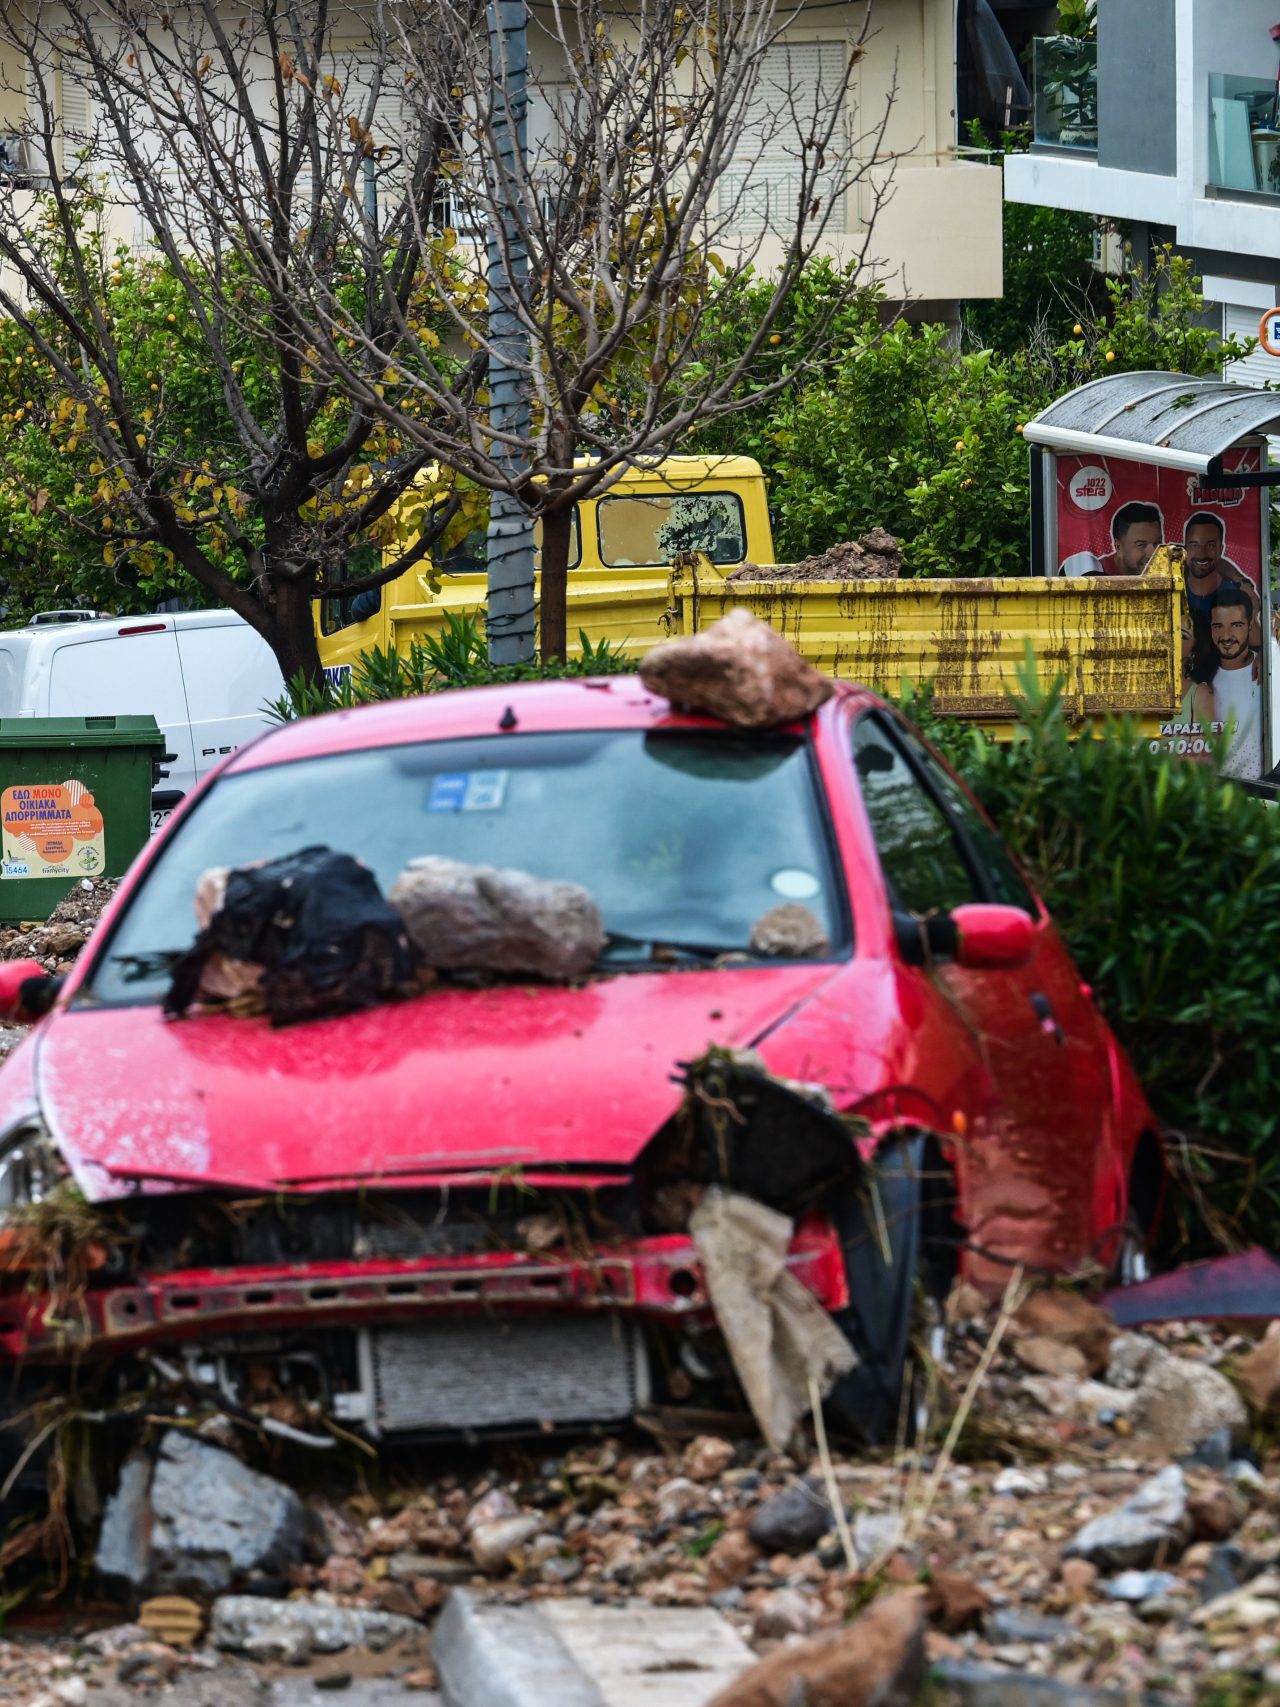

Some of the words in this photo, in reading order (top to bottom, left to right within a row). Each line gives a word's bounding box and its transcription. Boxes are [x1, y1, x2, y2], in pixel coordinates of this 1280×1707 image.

[1087, 478, 1106, 487] 1022
[1076, 484, 1106, 497] sfera
[12, 790, 31, 800] ΕΔΩ
[32, 788, 62, 799] ΜΟΝΟ
[19, 799, 56, 810] ΟΙΚΙΑΚΑ
[5, 810, 72, 822] ΑΠΟΡΡΙΜΜΑΤΑ
